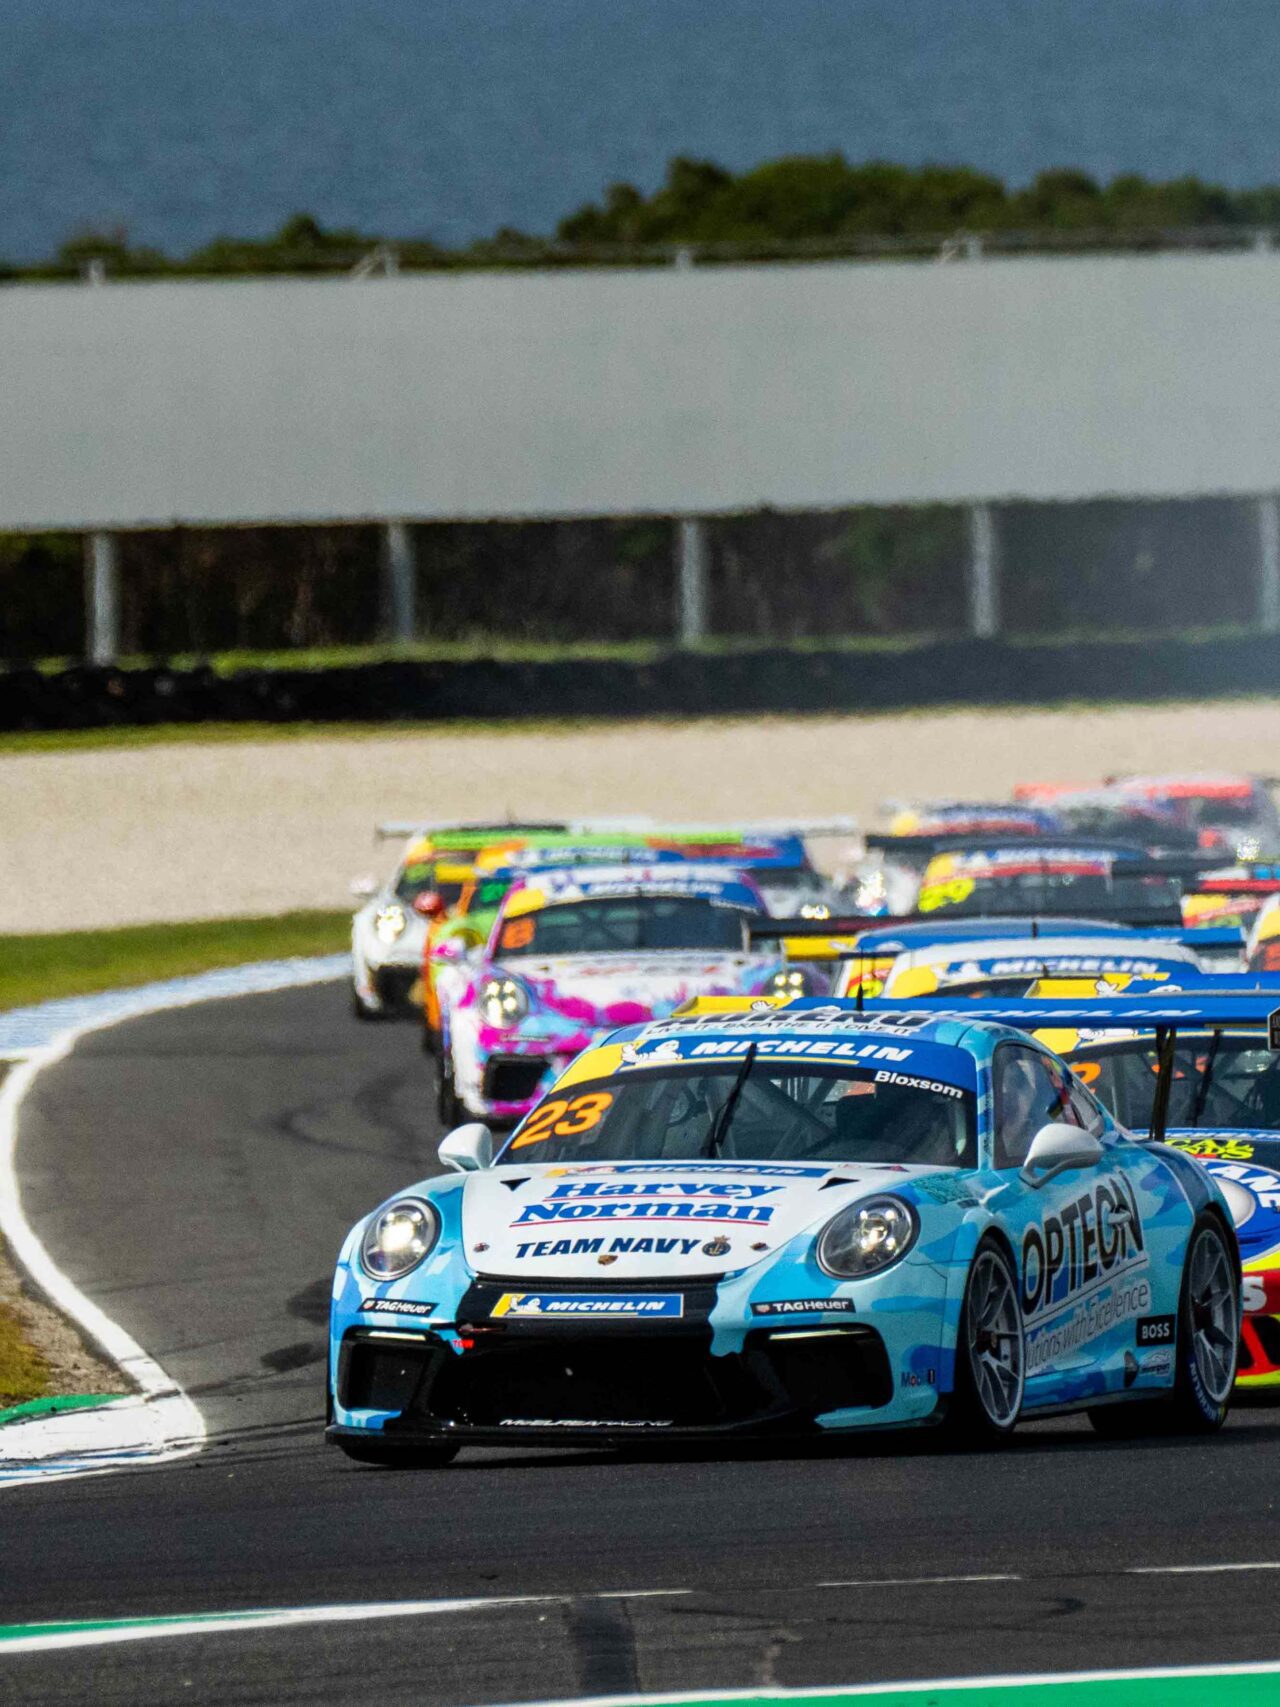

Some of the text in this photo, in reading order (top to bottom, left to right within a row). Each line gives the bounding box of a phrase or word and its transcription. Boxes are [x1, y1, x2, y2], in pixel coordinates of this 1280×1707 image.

[690, 1040, 914, 1062] MICHELIN
[874, 1070, 964, 1099] Bloxsom
[511, 1093, 613, 1150] 23
[627, 1165, 805, 1175] MICHELIN
[548, 1182, 786, 1200] Harvey
[513, 1201, 775, 1223] Norman
[515, 1237, 702, 1259] TEAM NAVY
[546, 1301, 667, 1311] MICHELIN
[1141, 1322, 1171, 1340] BOSS
[453, 1339, 475, 1349] TOW
